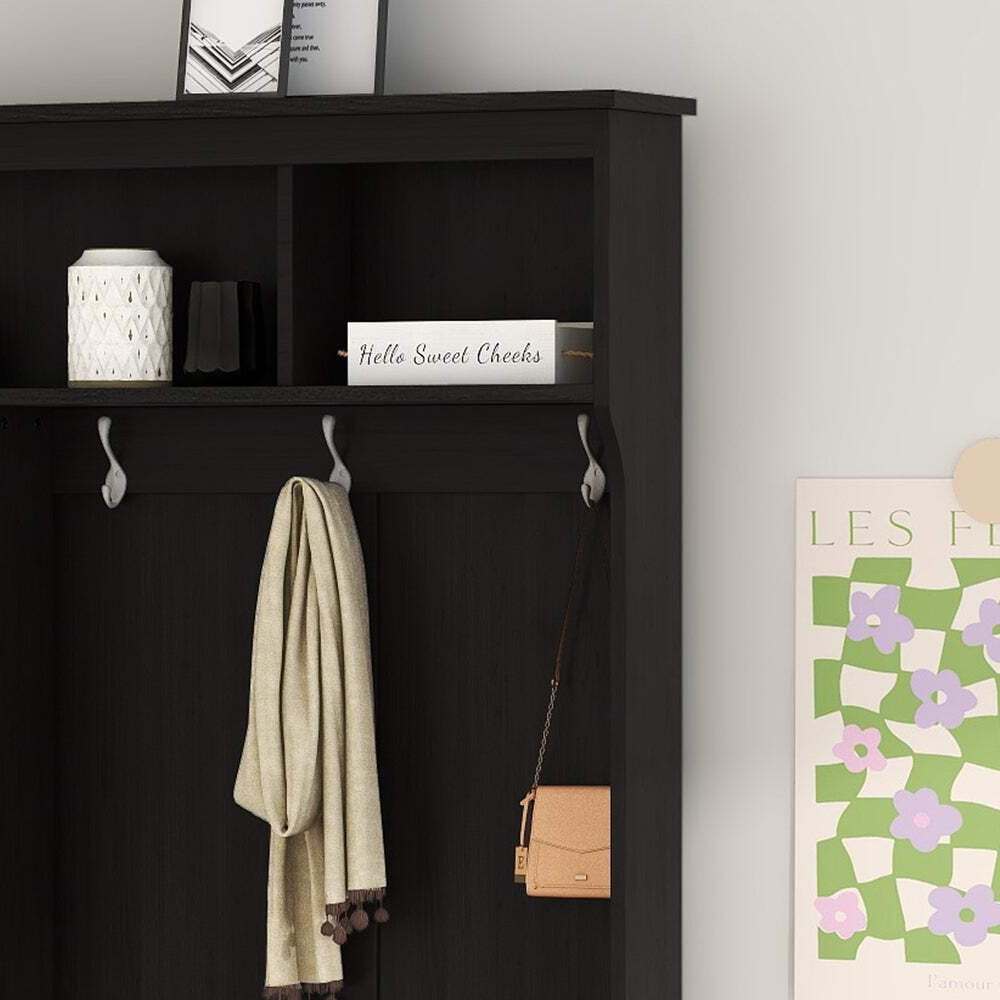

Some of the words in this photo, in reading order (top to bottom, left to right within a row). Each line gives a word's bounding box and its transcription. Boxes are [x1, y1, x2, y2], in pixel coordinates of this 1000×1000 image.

[359, 344, 405, 365] Hello
[413, 343, 470, 365] Sweet
[477, 342, 542, 364] Cheeks
[811, 509, 914, 546] LES
